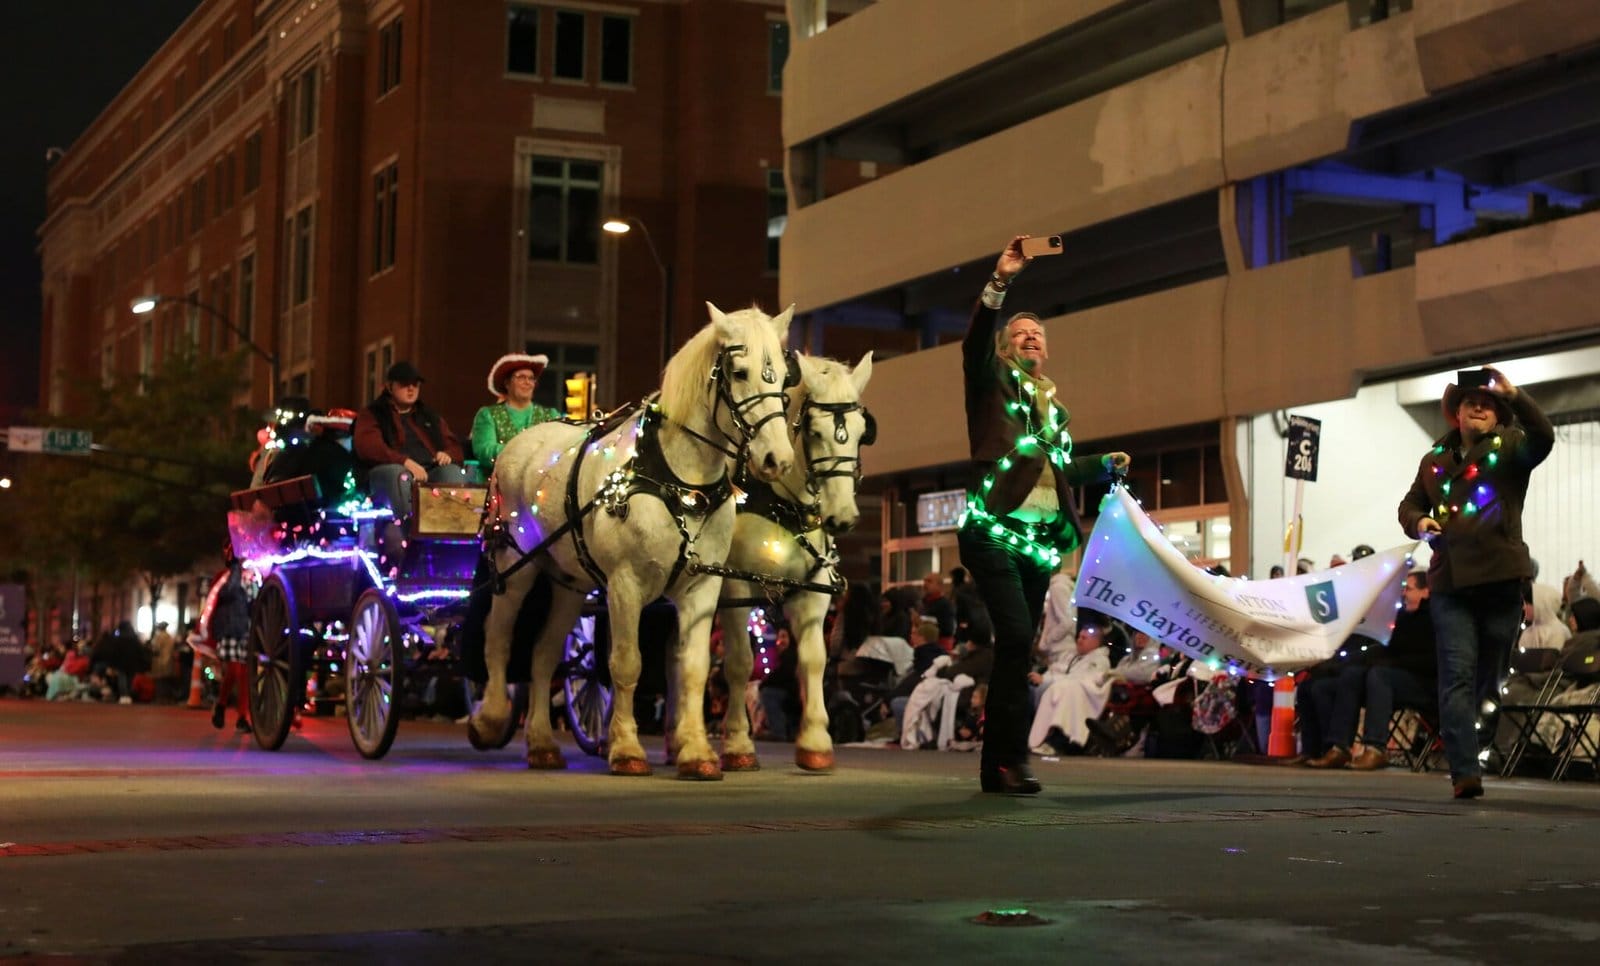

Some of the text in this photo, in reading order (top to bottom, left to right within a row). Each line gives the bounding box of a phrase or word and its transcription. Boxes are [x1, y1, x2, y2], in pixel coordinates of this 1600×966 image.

[1299, 439, 1312, 456] C
[1083, 576, 1126, 607] The
[1130, 600, 1215, 656] Stayton
[1315, 590, 1330, 617] S
